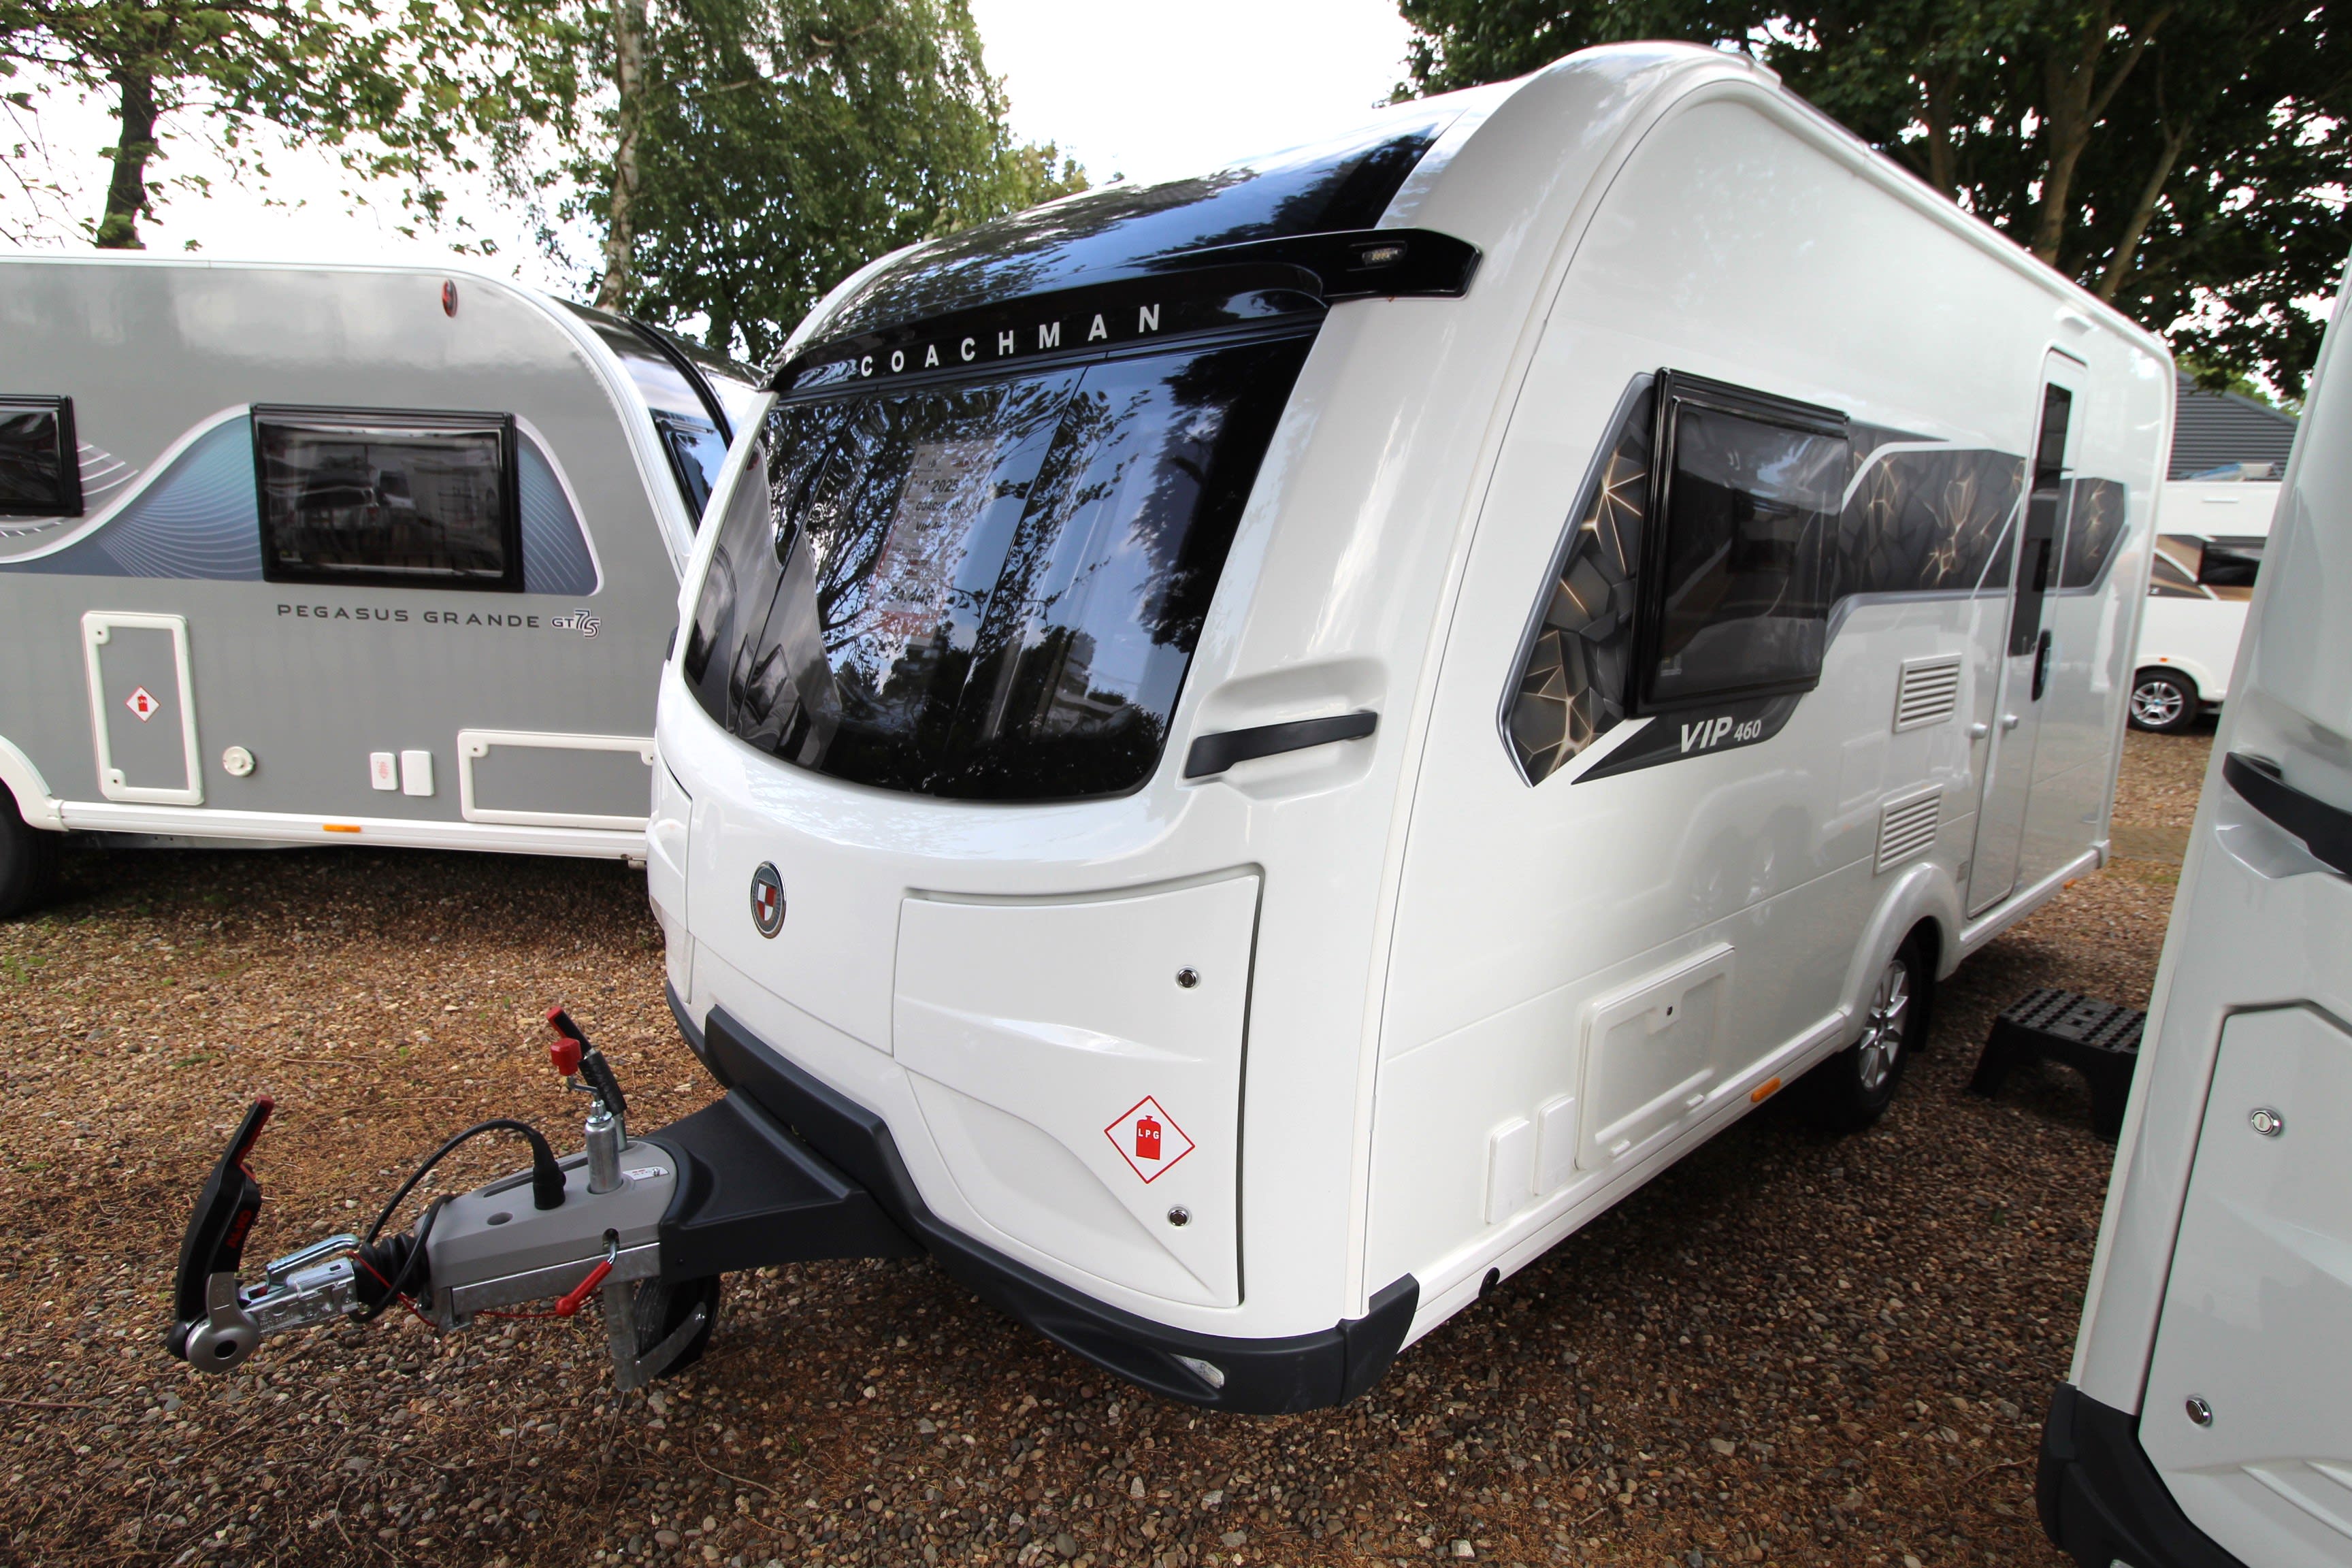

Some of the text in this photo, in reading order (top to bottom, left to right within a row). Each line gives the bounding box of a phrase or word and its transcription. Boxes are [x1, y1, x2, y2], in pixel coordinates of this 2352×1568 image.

[860, 304, 1160, 378] COACHMAN
[276, 604, 409, 622] PEGASUS
[423, 611, 540, 628] GRANDE
[1680, 716, 1762, 753] VIP 460
[1137, 1128, 1160, 1140] LPG
